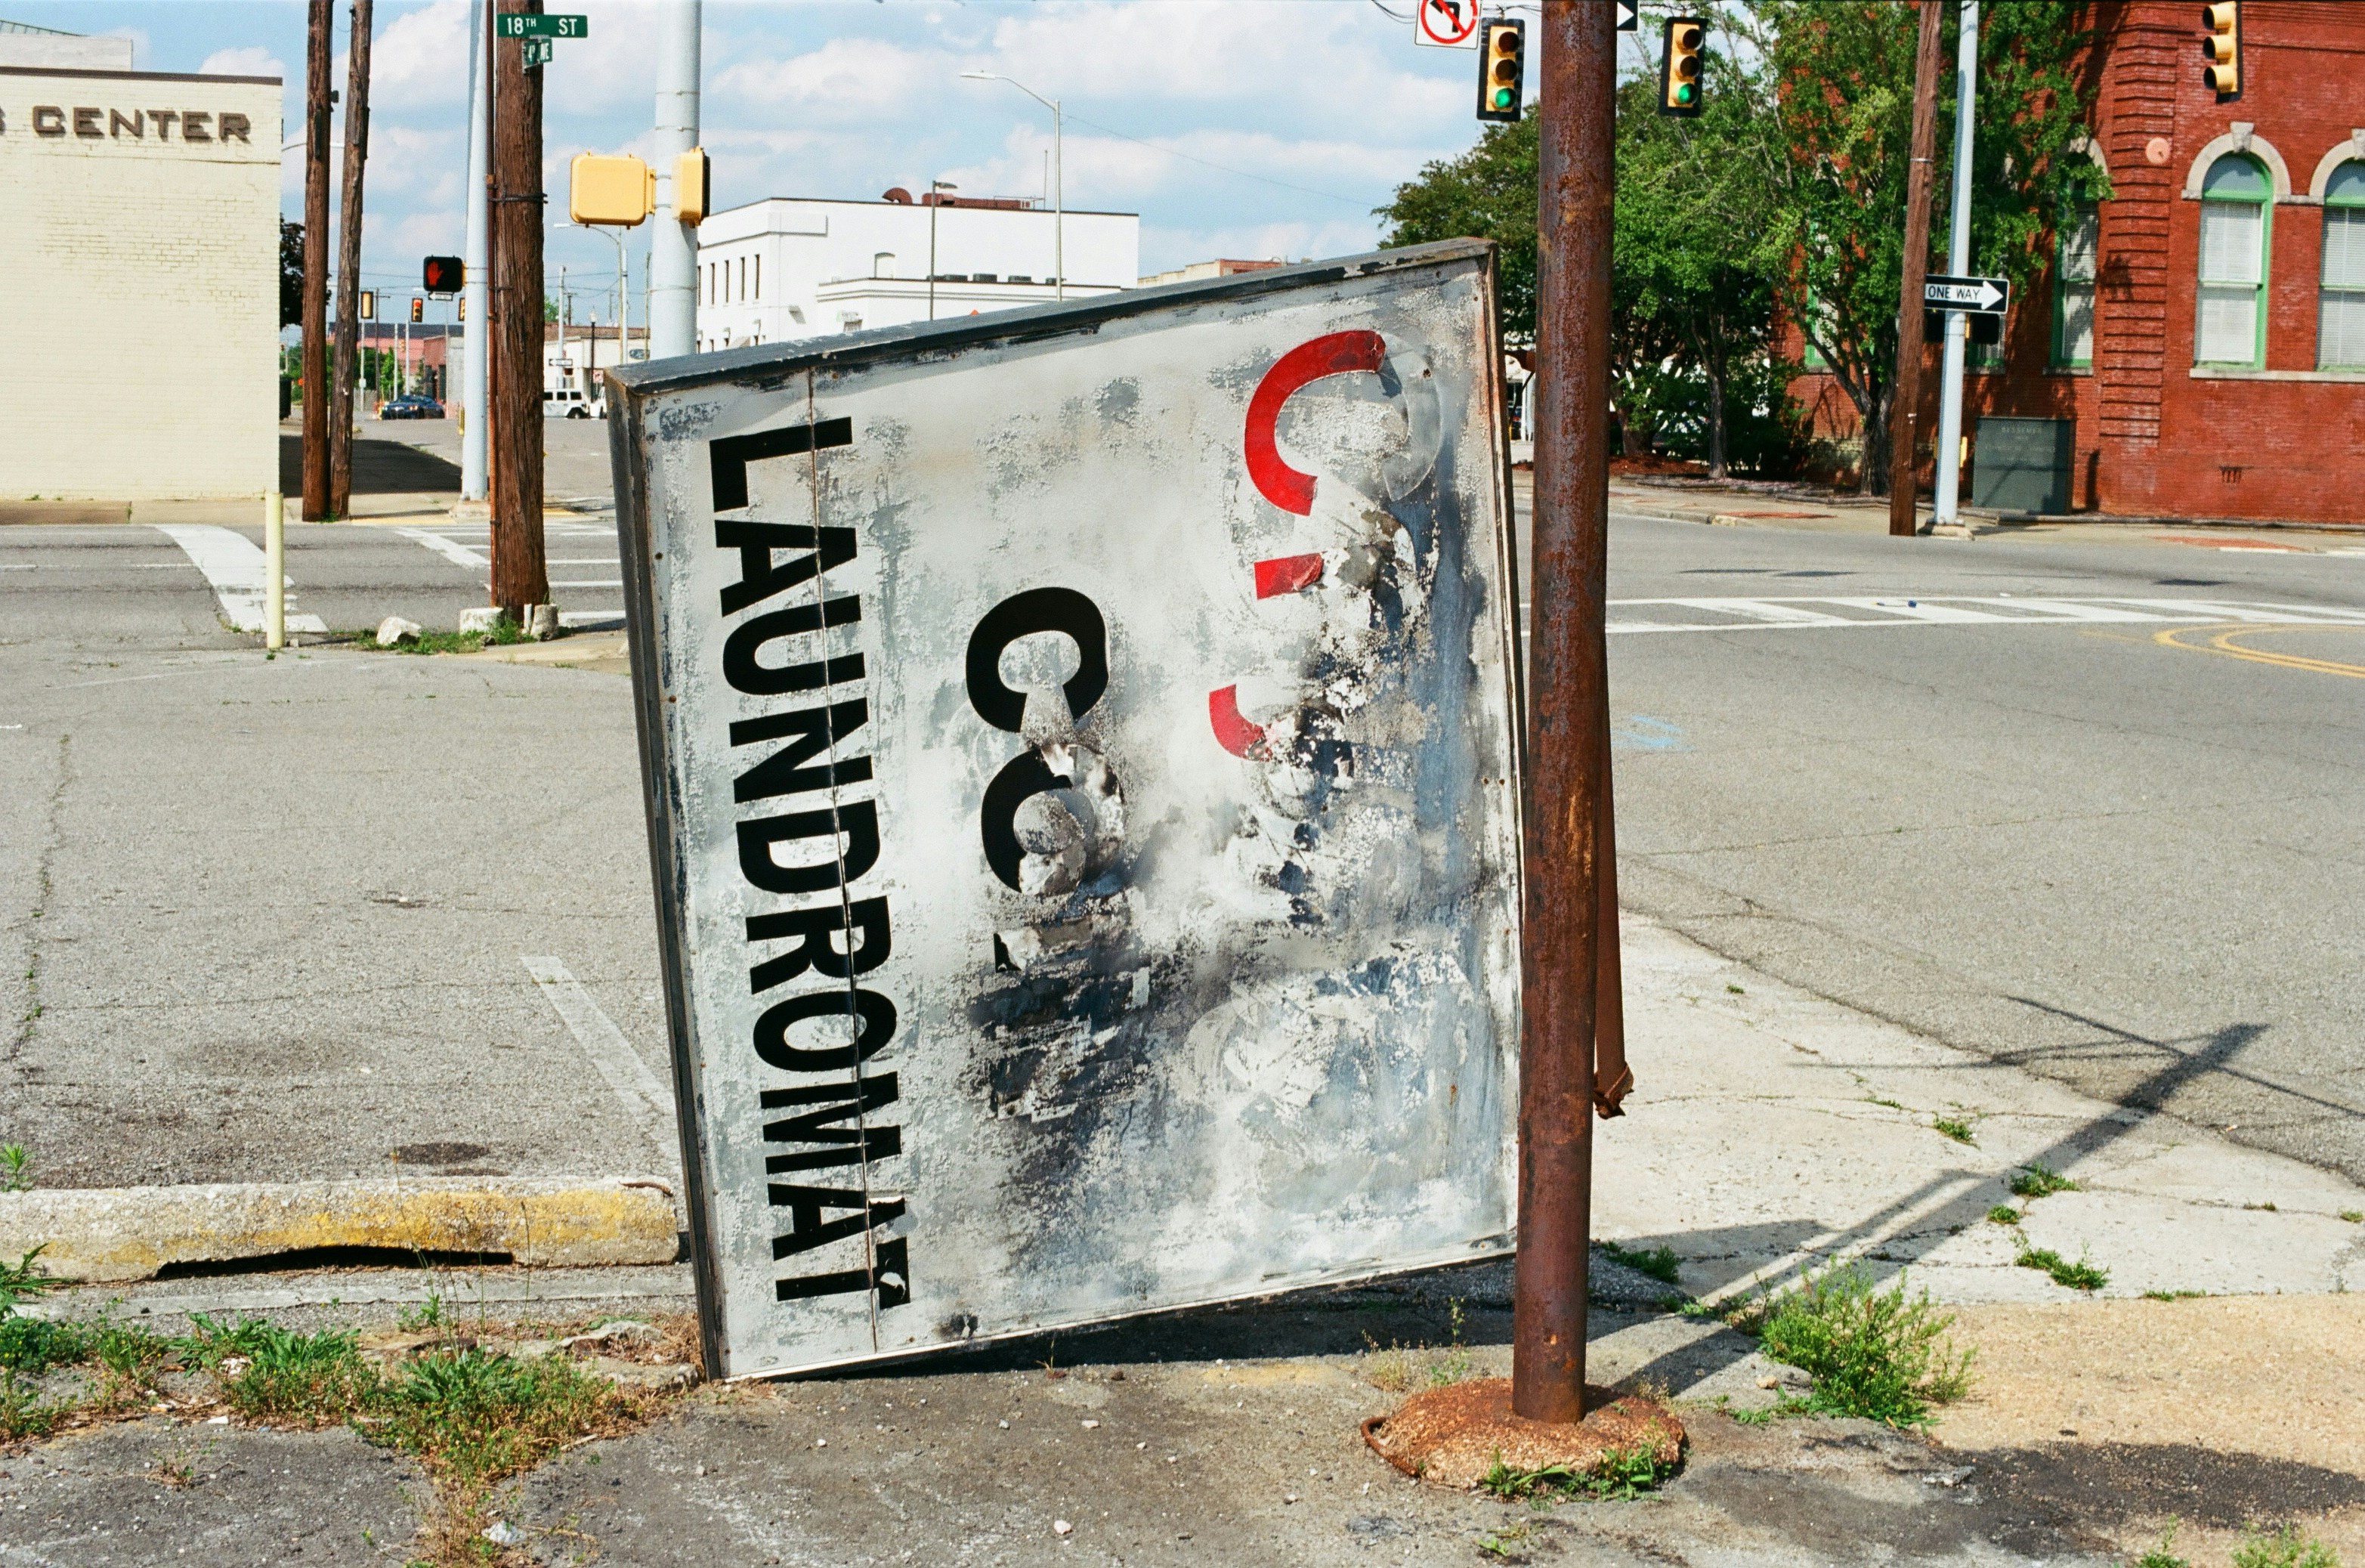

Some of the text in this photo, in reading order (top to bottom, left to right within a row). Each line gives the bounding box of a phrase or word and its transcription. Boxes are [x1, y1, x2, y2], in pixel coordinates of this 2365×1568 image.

[507, 17, 577, 36] 18TH ST
[32, 104, 251, 144] CENTER
[1928, 286, 1980, 300] ONE WAY
[709, 416, 910, 1310] LAUNDROMAT
